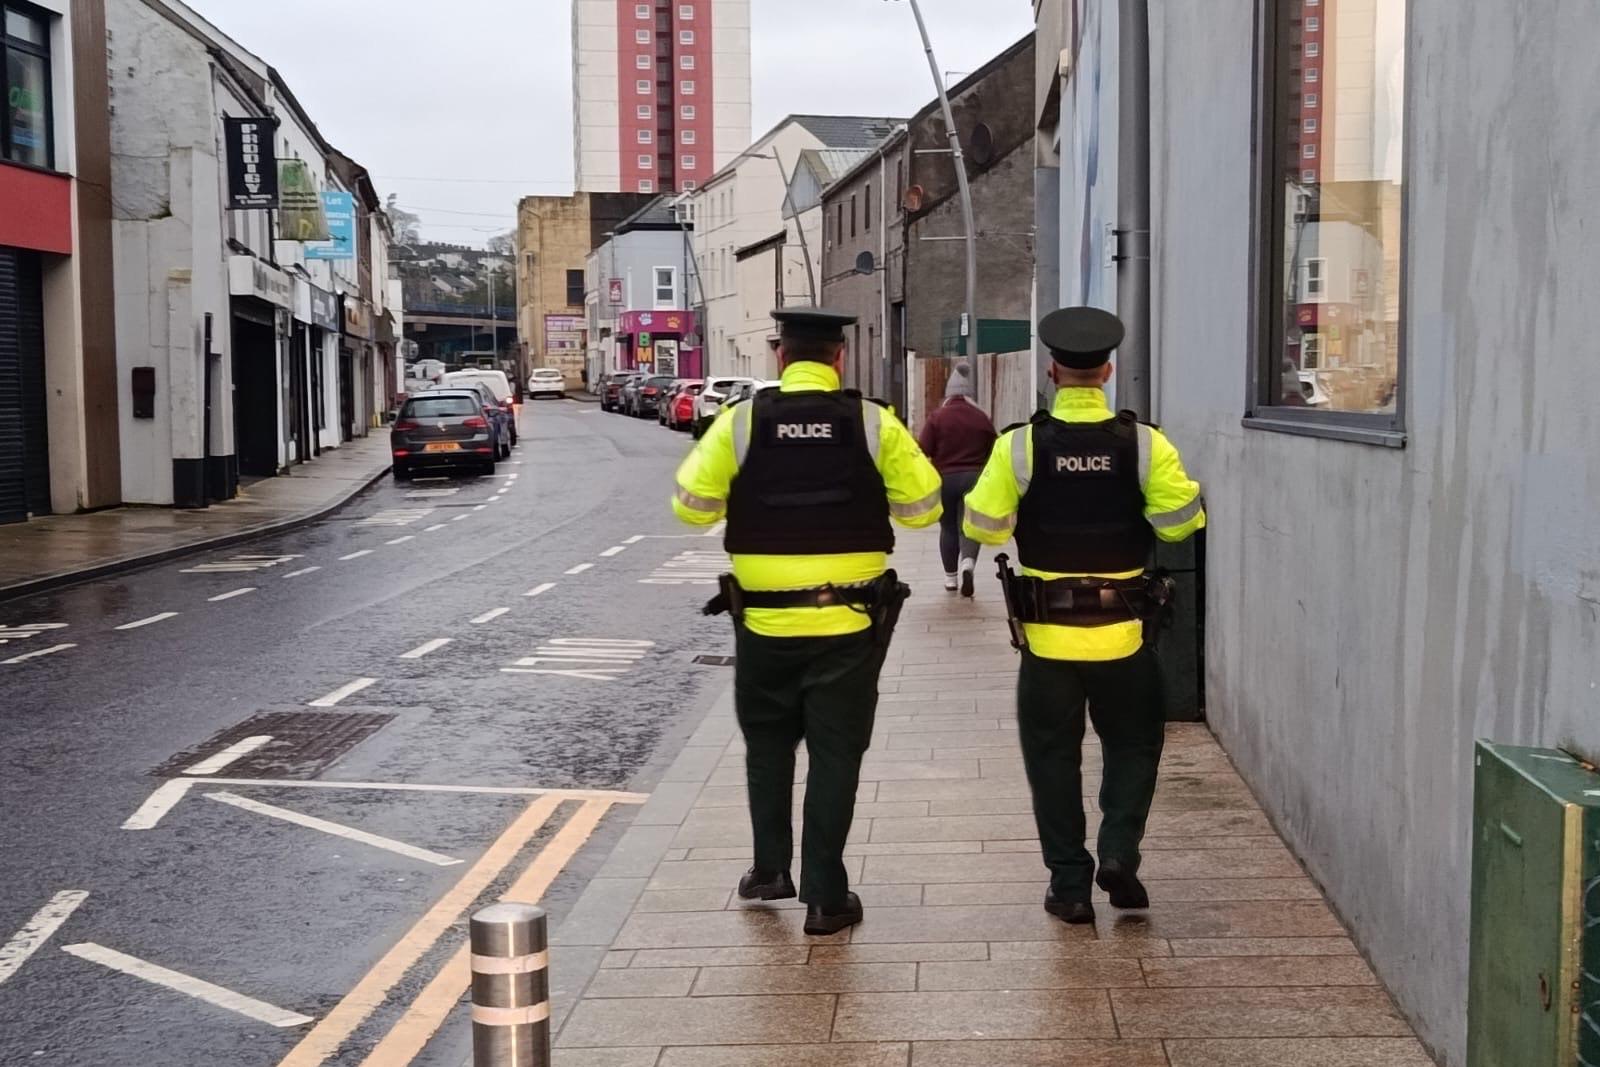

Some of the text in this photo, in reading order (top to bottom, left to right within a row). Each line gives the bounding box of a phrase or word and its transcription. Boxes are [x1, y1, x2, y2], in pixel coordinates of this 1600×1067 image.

[241, 123, 260, 193] PRODIGY
[777, 423, 832, 439] POLICE
[1056, 456, 1111, 472] POLICE
[499, 638, 655, 681] ONLY
